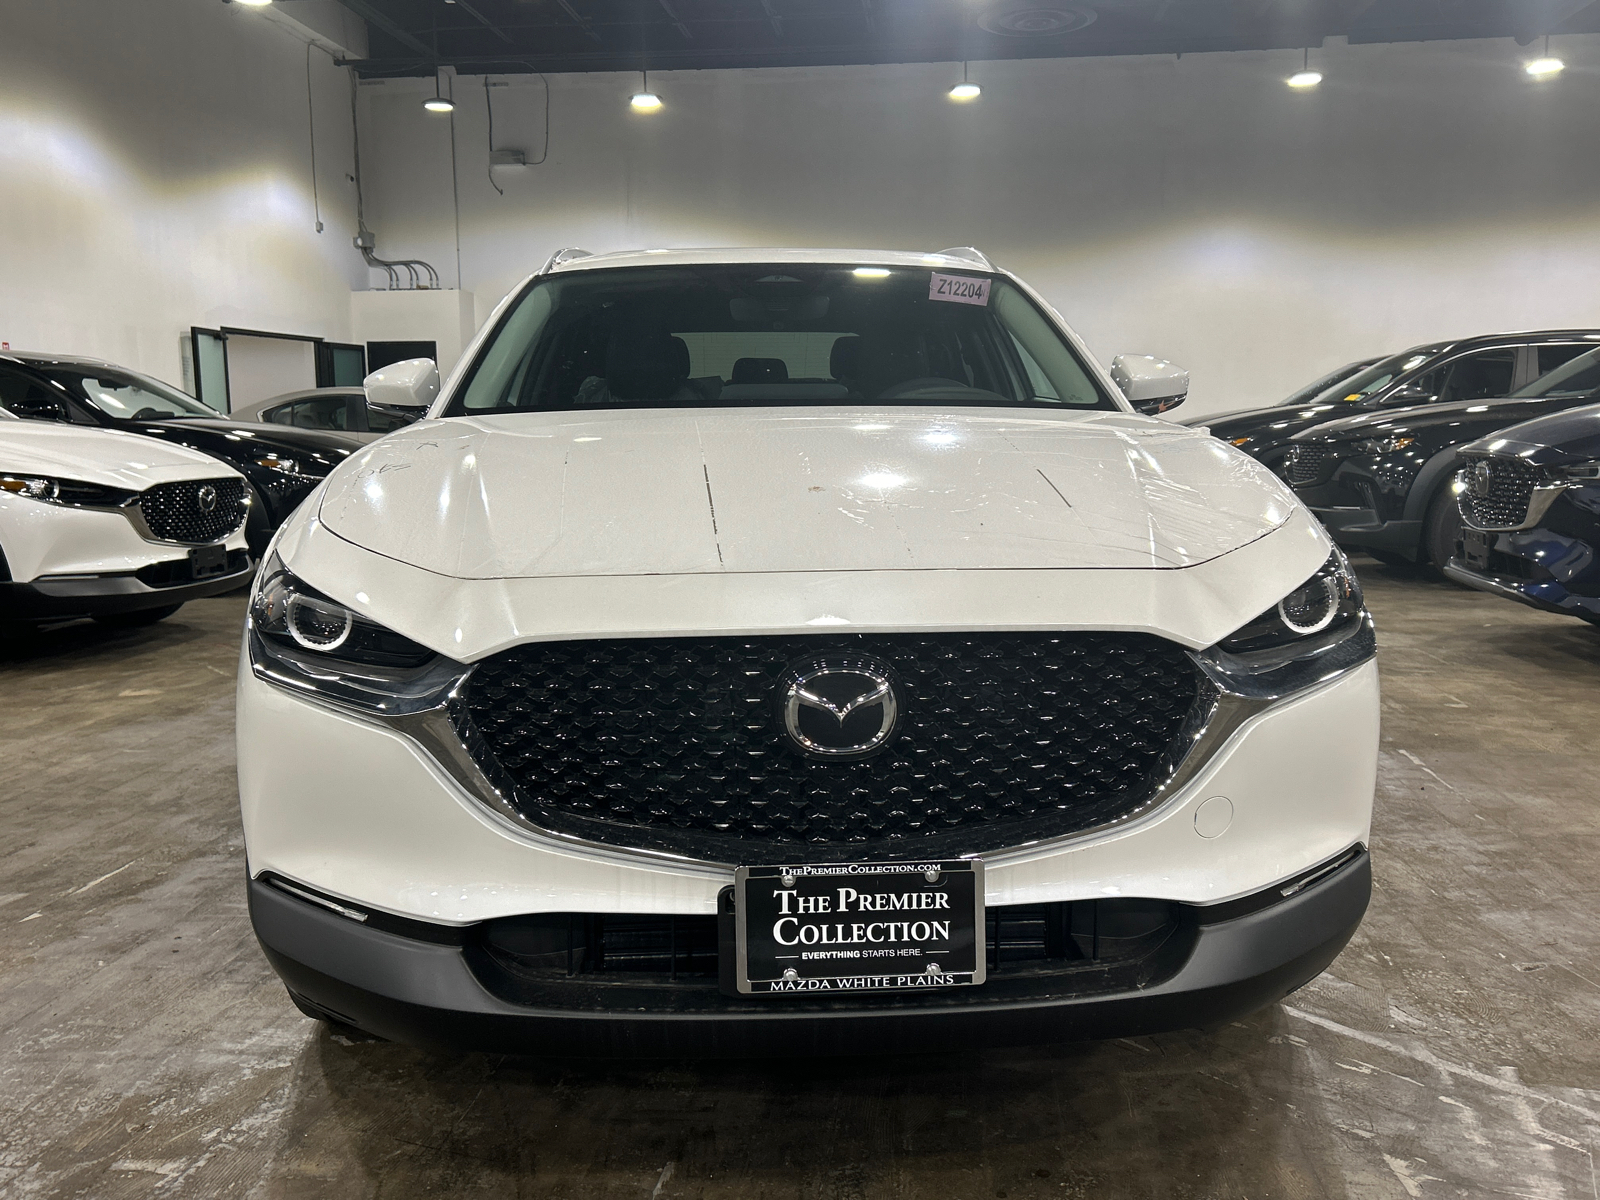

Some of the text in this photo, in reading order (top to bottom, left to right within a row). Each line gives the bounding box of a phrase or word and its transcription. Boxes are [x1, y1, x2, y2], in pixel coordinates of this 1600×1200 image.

[937, 279, 982, 299] Z12204
[802, 948, 923, 960] EVERYTHING STARTS HERE.
[770, 974, 955, 991] MAZDA WHITE PLAINS
